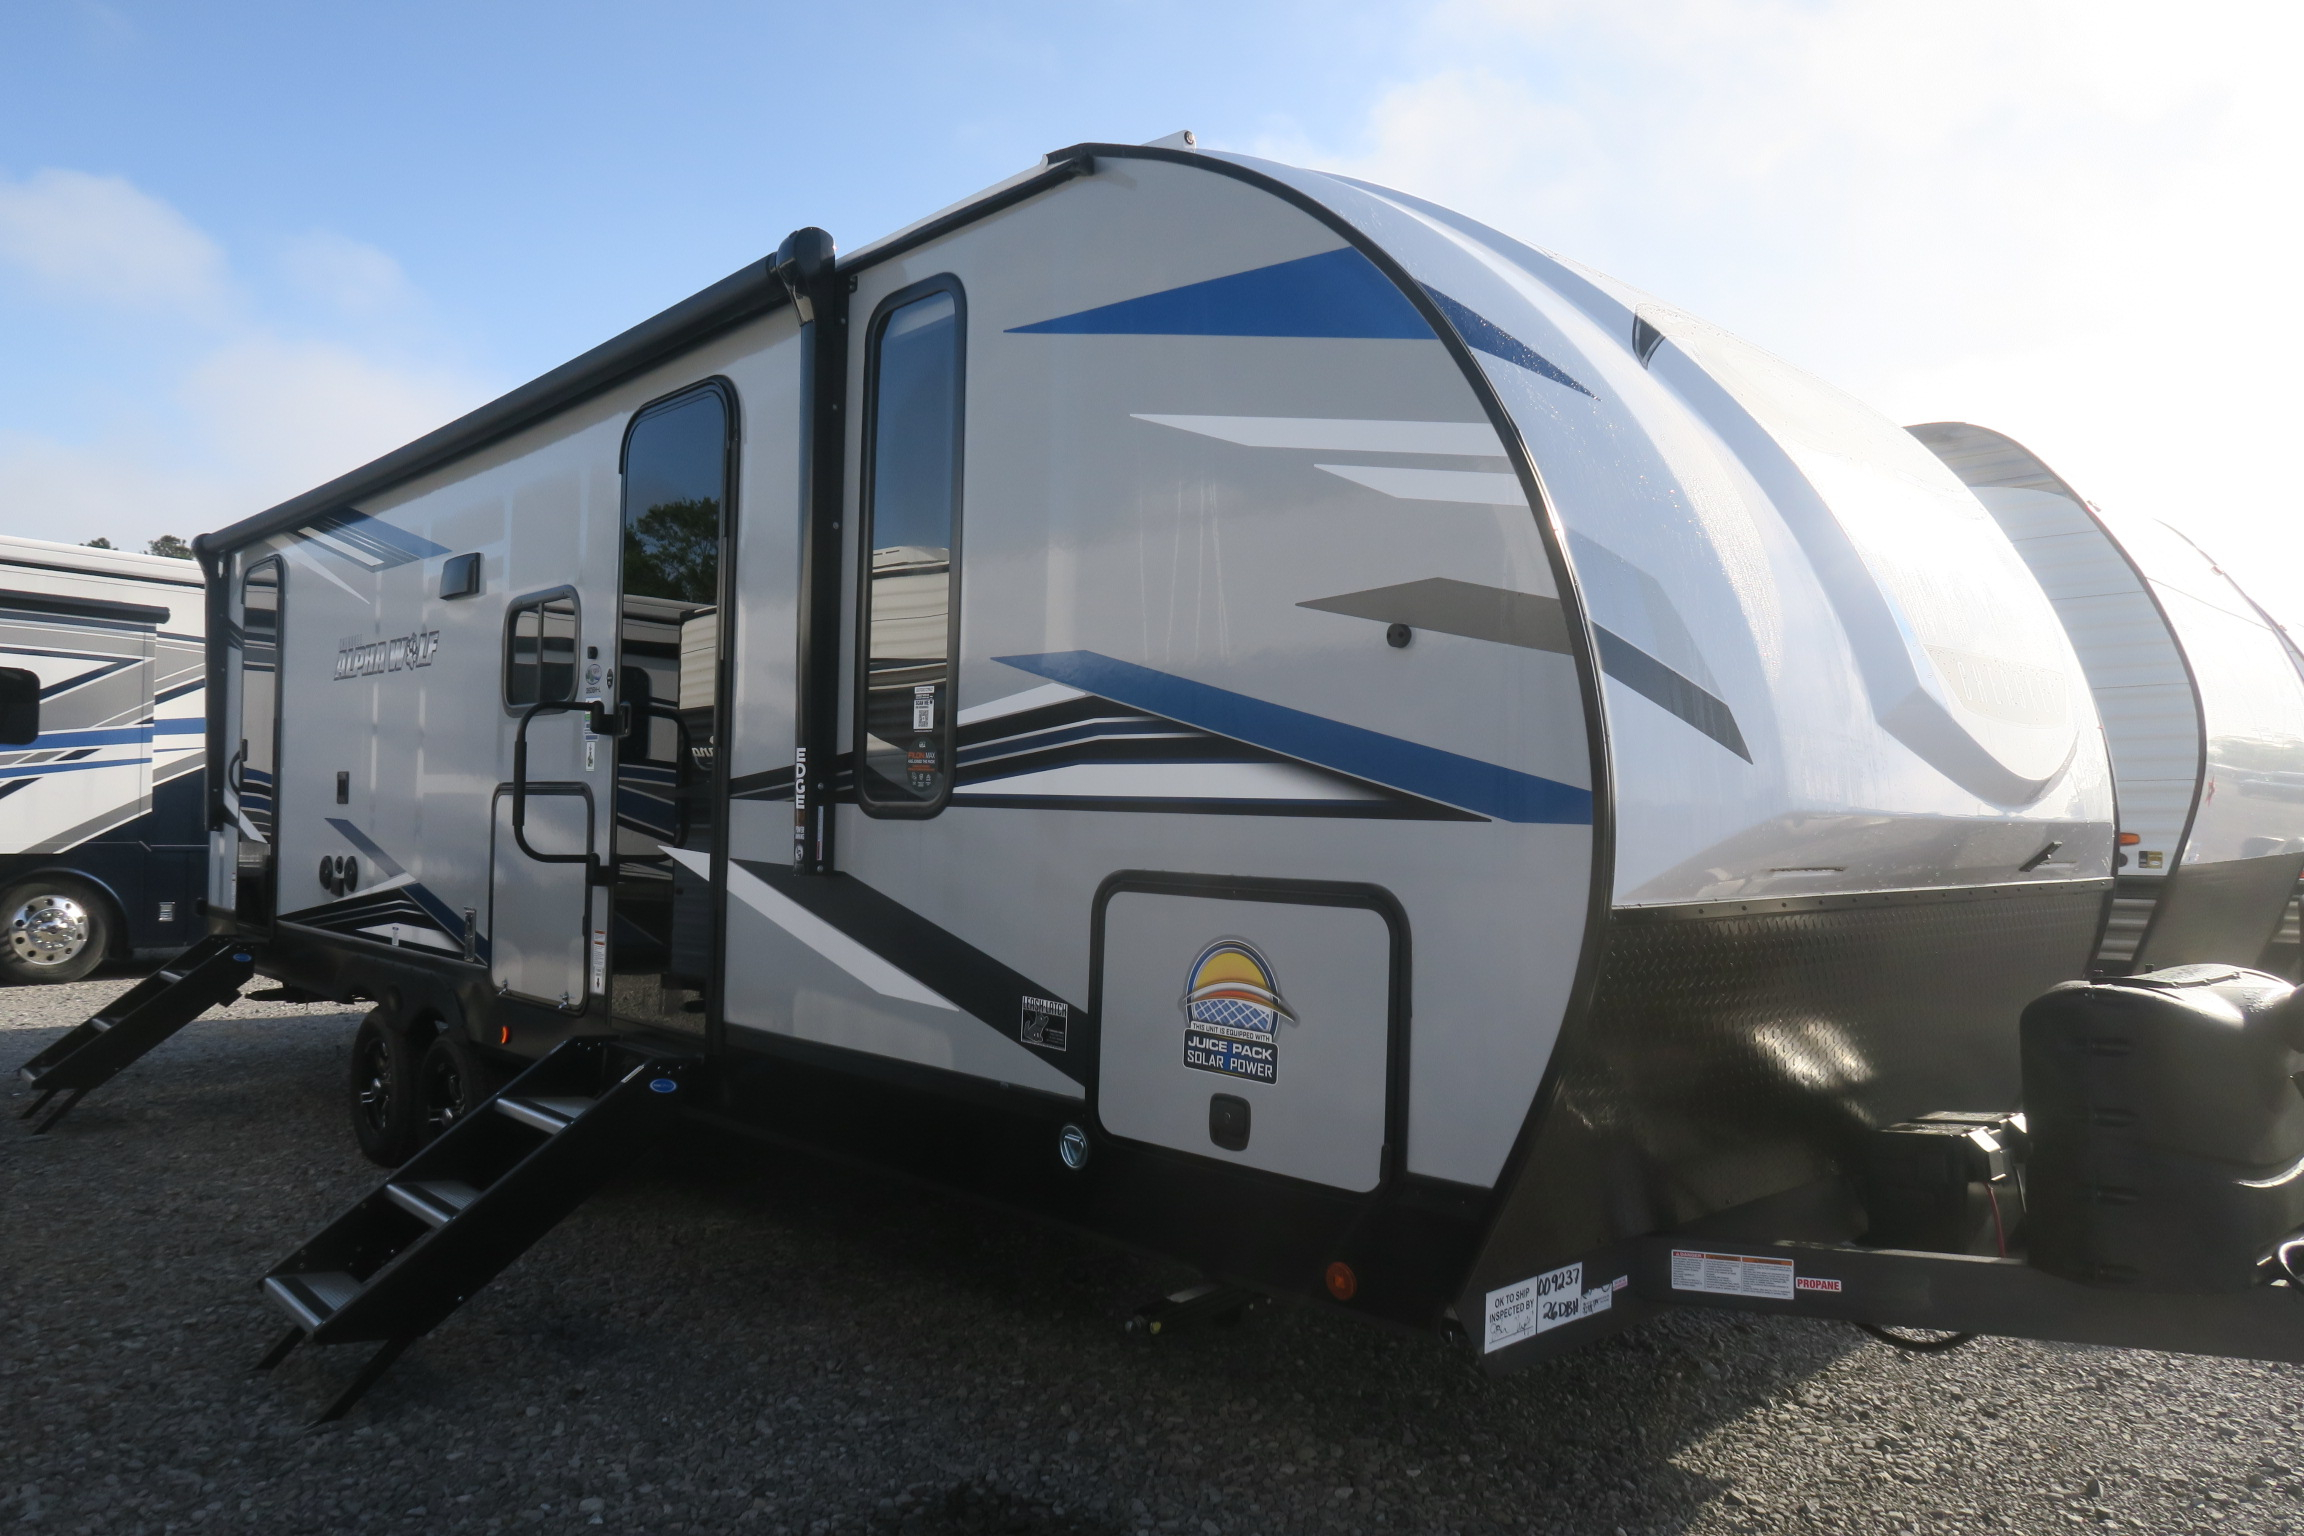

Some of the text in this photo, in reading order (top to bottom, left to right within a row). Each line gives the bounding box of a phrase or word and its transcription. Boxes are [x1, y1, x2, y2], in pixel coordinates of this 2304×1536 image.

[333, 641, 386, 681] ALPHA
[796, 747, 807, 810] EDGE
[1193, 1022, 1270, 1042] THIS UNIT IS EQUIPPED WITH
[1187, 1036, 1273, 1062] JUICE PACK
[1187, 1050, 1273, 1078] SOLAR POWER
[1797, 1278, 1840, 1291] PROPANE
[1494, 1287, 1530, 1309] OK TO SHIP
[1489, 1299, 1535, 1324] INSPECTED BY
